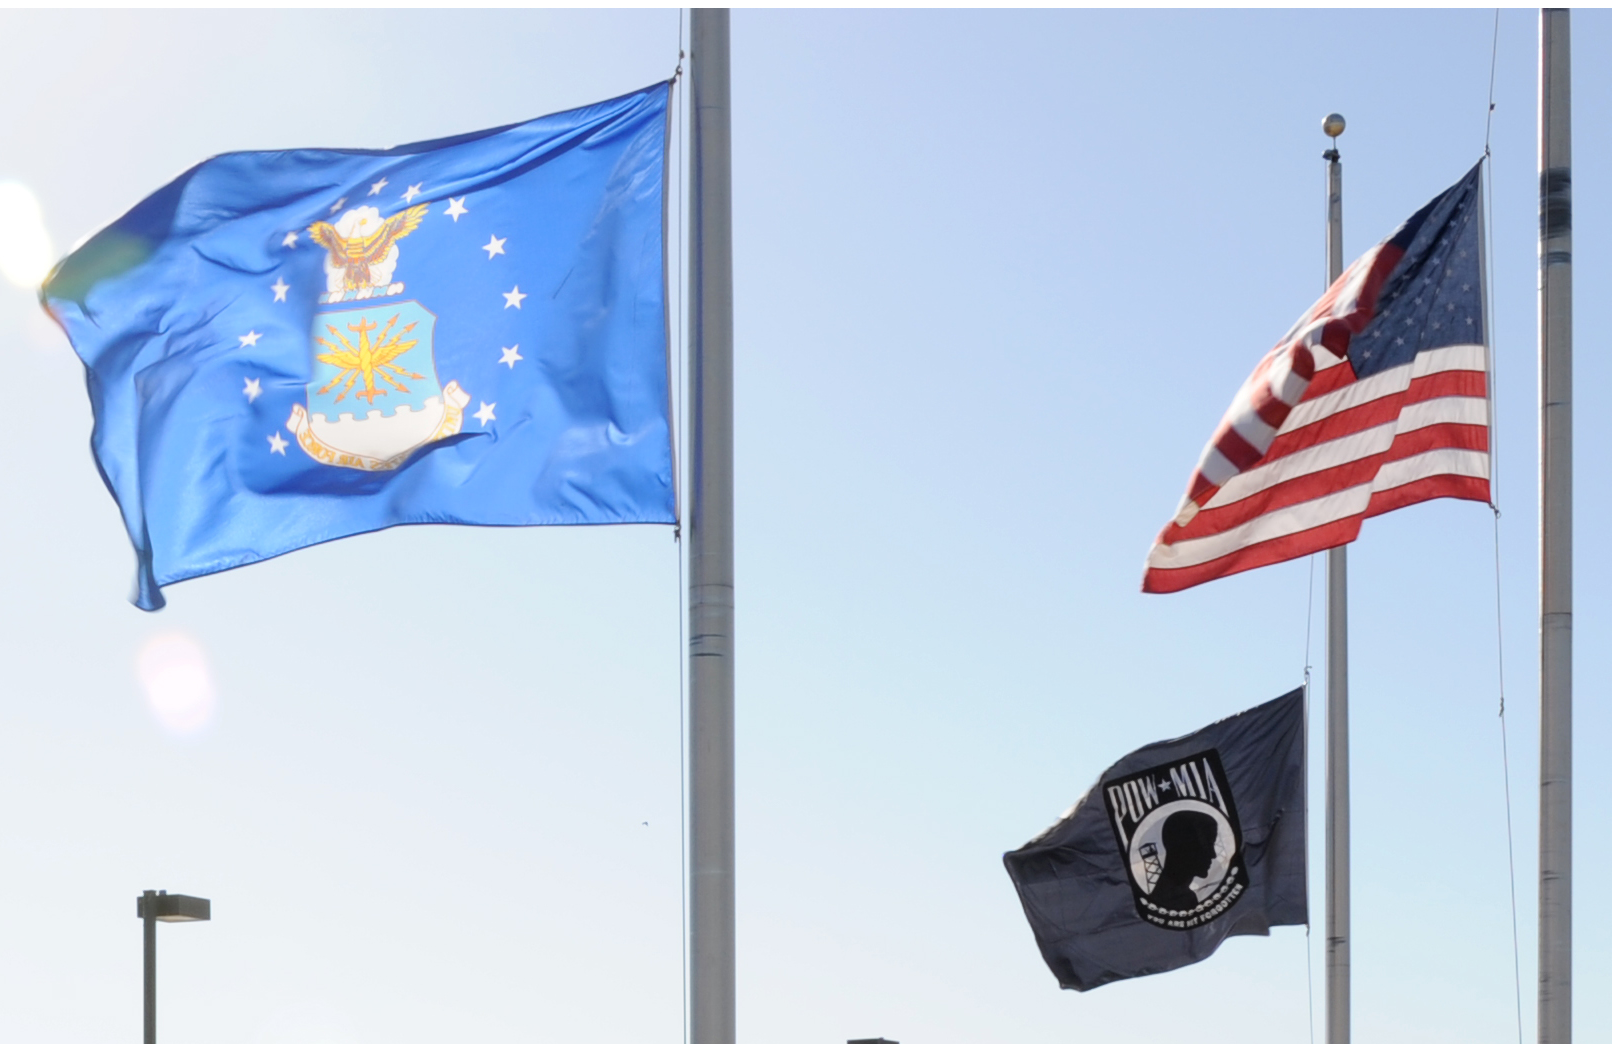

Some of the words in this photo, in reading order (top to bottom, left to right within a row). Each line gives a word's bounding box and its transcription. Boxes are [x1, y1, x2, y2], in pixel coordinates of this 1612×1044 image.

[1107, 774, 1159, 853] POW
[1170, 757, 1229, 818] MIA
[1200, 883, 1243, 922] FORGOTTEN
